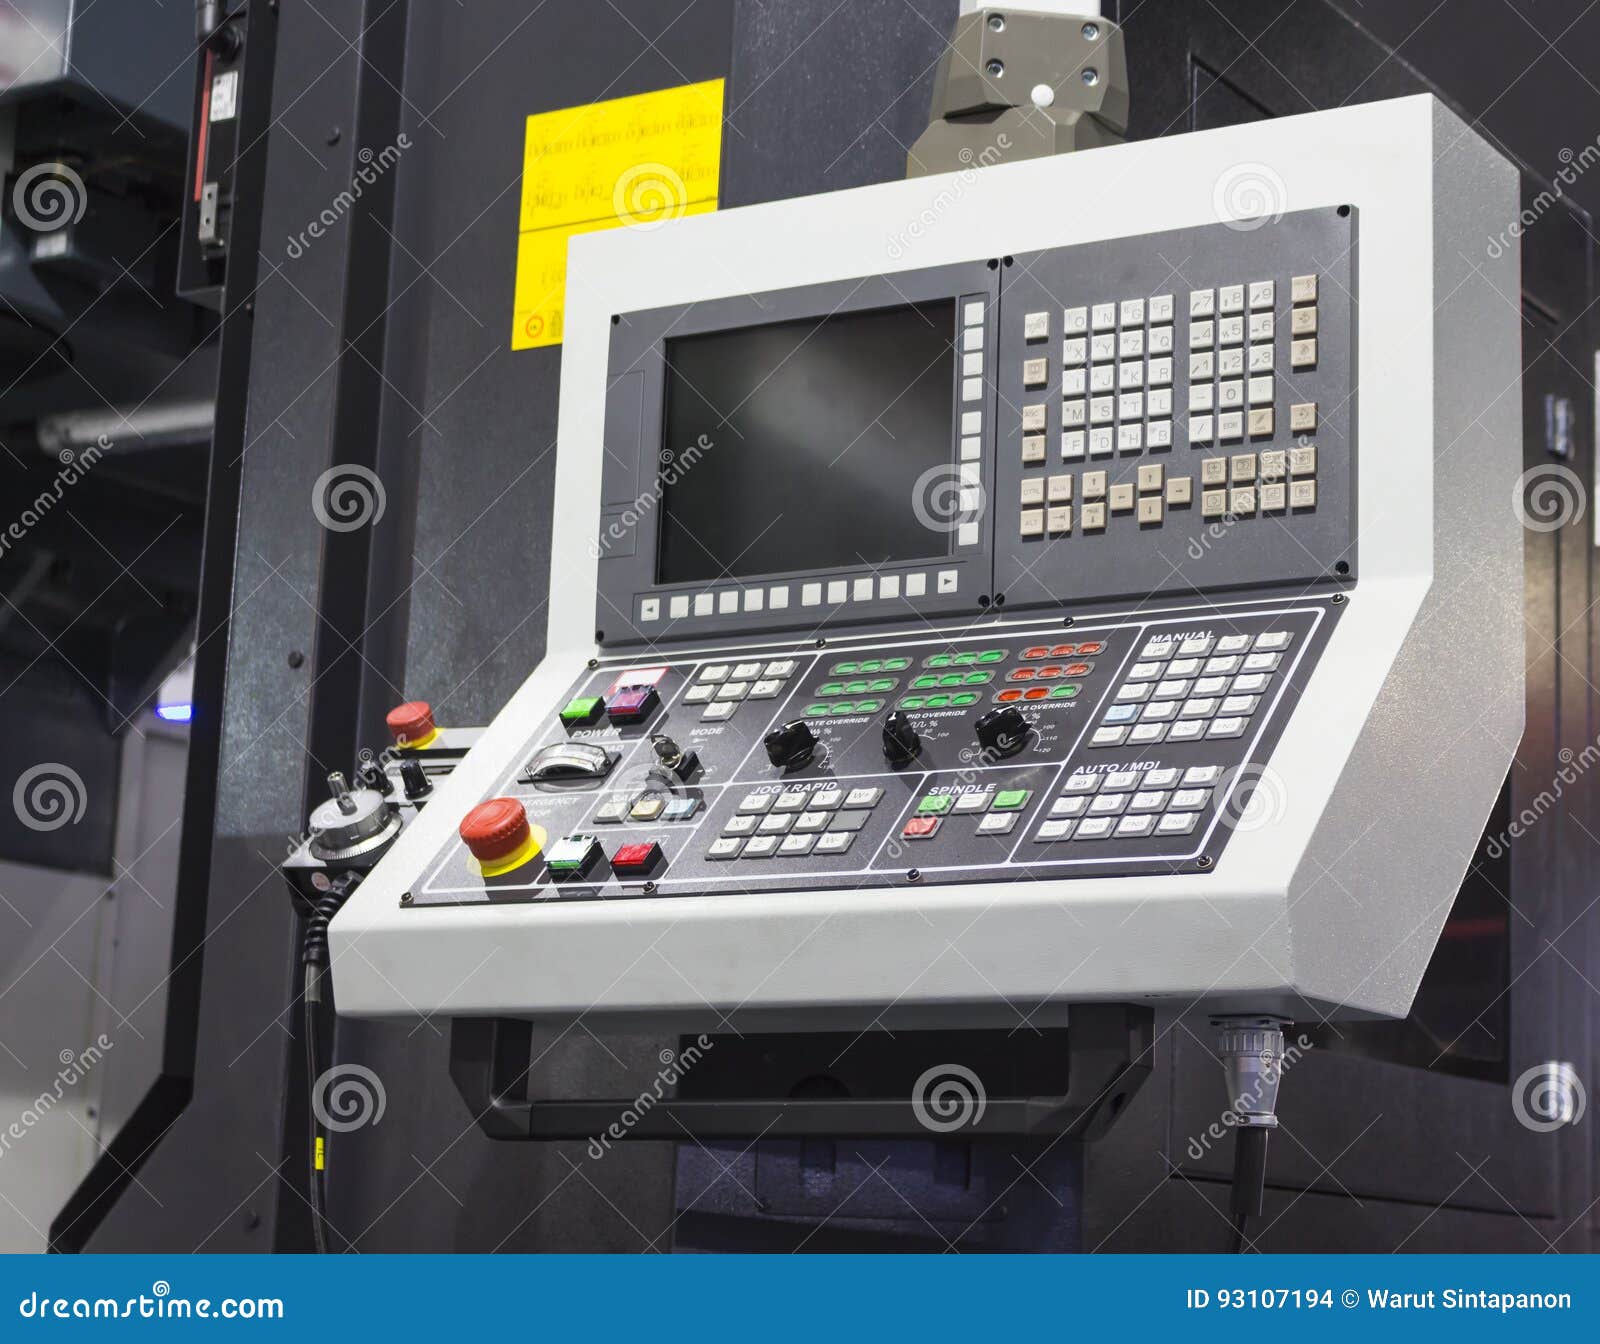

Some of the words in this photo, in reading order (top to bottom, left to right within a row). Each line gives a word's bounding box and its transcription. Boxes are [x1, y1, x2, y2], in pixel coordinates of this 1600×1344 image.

[1150, 630, 1215, 643] MANUAL
[689, 727, 724, 737] MODE
[928, 783, 997, 796] SPINDLE
